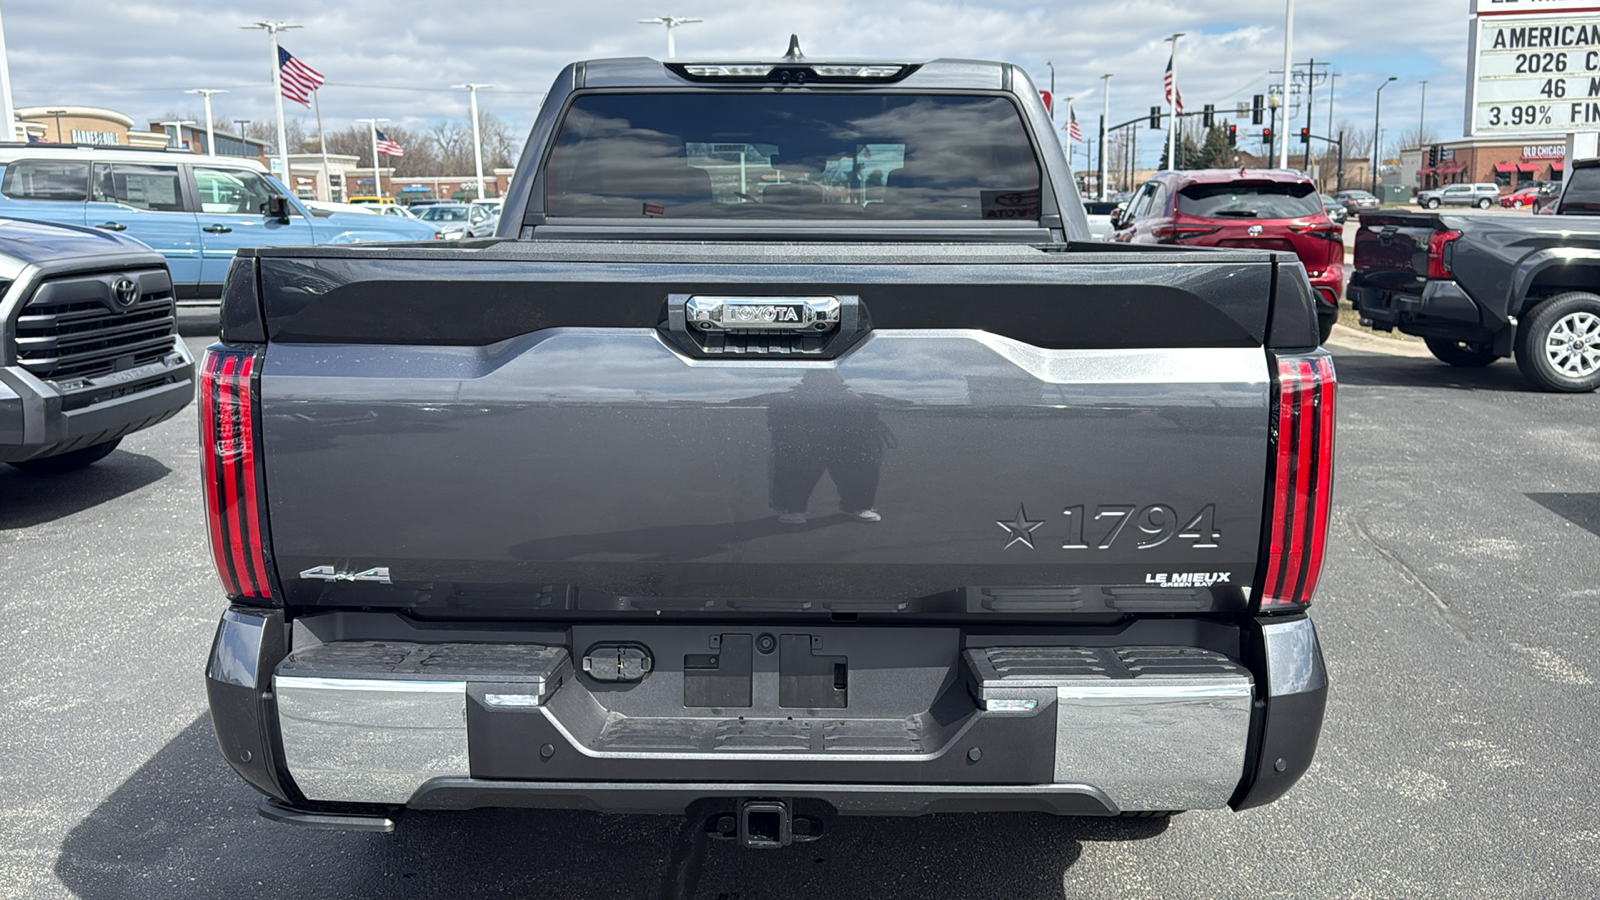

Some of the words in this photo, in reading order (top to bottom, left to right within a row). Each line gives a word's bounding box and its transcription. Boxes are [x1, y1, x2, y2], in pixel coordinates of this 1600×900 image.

[1515, 52, 1568, 74] 2026
[1585, 51, 1600, 71] C
[1540, 78, 1566, 98] 46
[1489, 104, 1552, 126] 3.99%
[1523, 145, 1536, 157] OLD
[1537, 144, 1566, 157] CHICAGO
[727, 305, 799, 321] TOYOTA
[1062, 503, 1222, 550] 1794
[1145, 573, 1168, 583] LE
[1171, 572, 1231, 583] MIEUX
